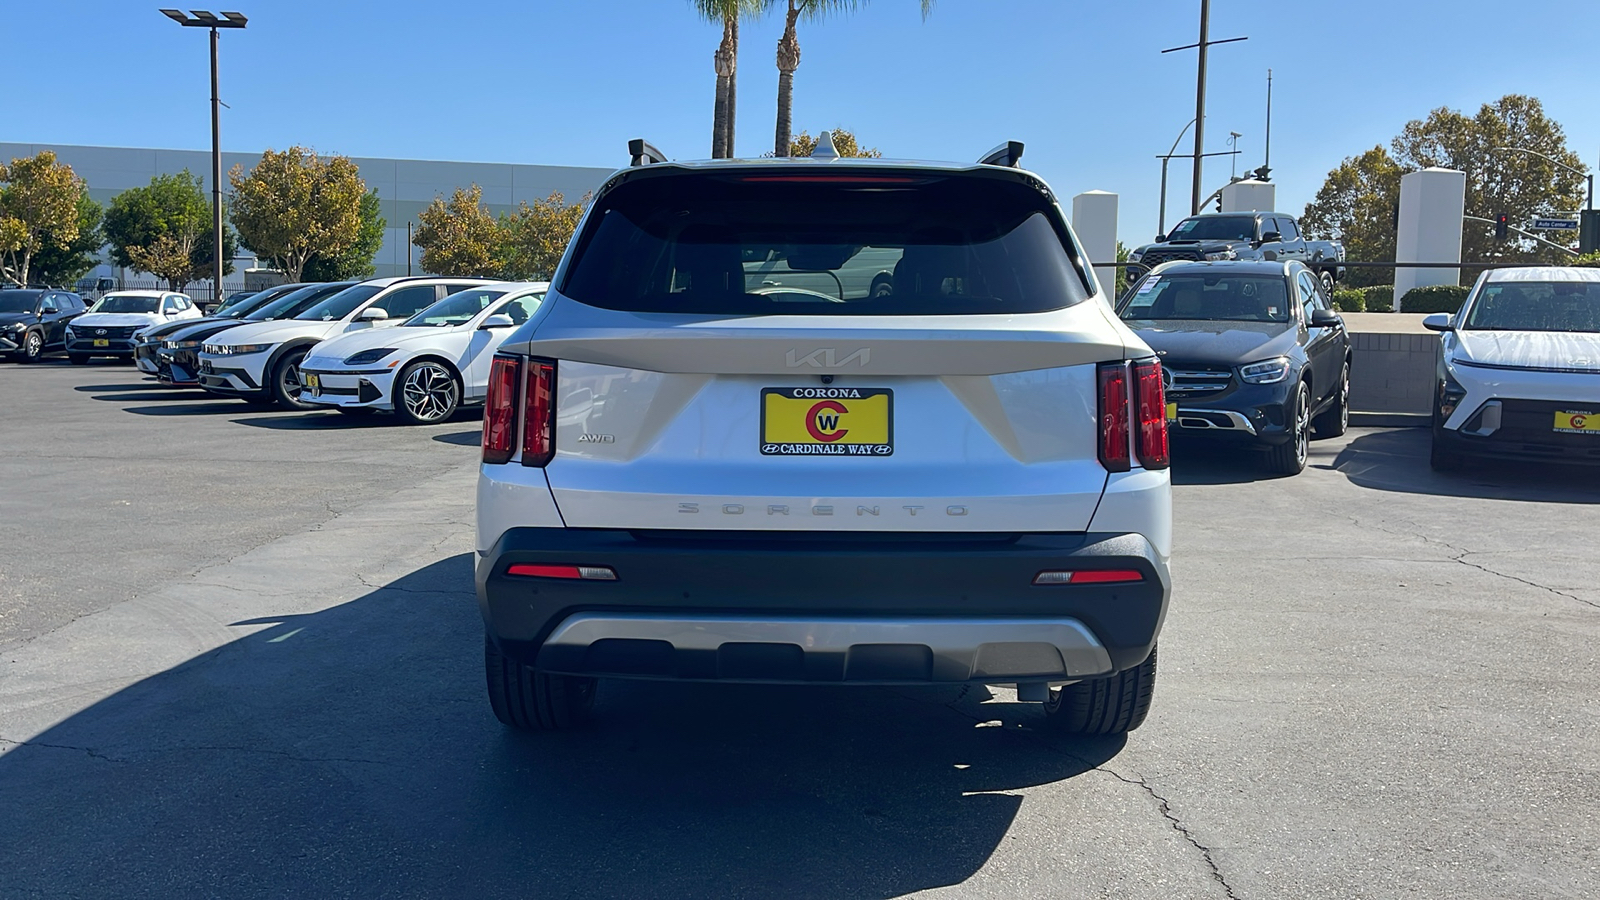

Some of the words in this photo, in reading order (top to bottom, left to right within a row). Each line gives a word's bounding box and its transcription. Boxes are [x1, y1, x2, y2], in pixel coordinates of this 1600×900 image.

[785, 347, 871, 368] KIA
[793, 388, 861, 398] CORONA
[578, 433, 615, 444] AWD
[780, 444, 846, 455] CARDINALE
[848, 444, 873, 455] WAY
[678, 502, 969, 516] SORENTO
